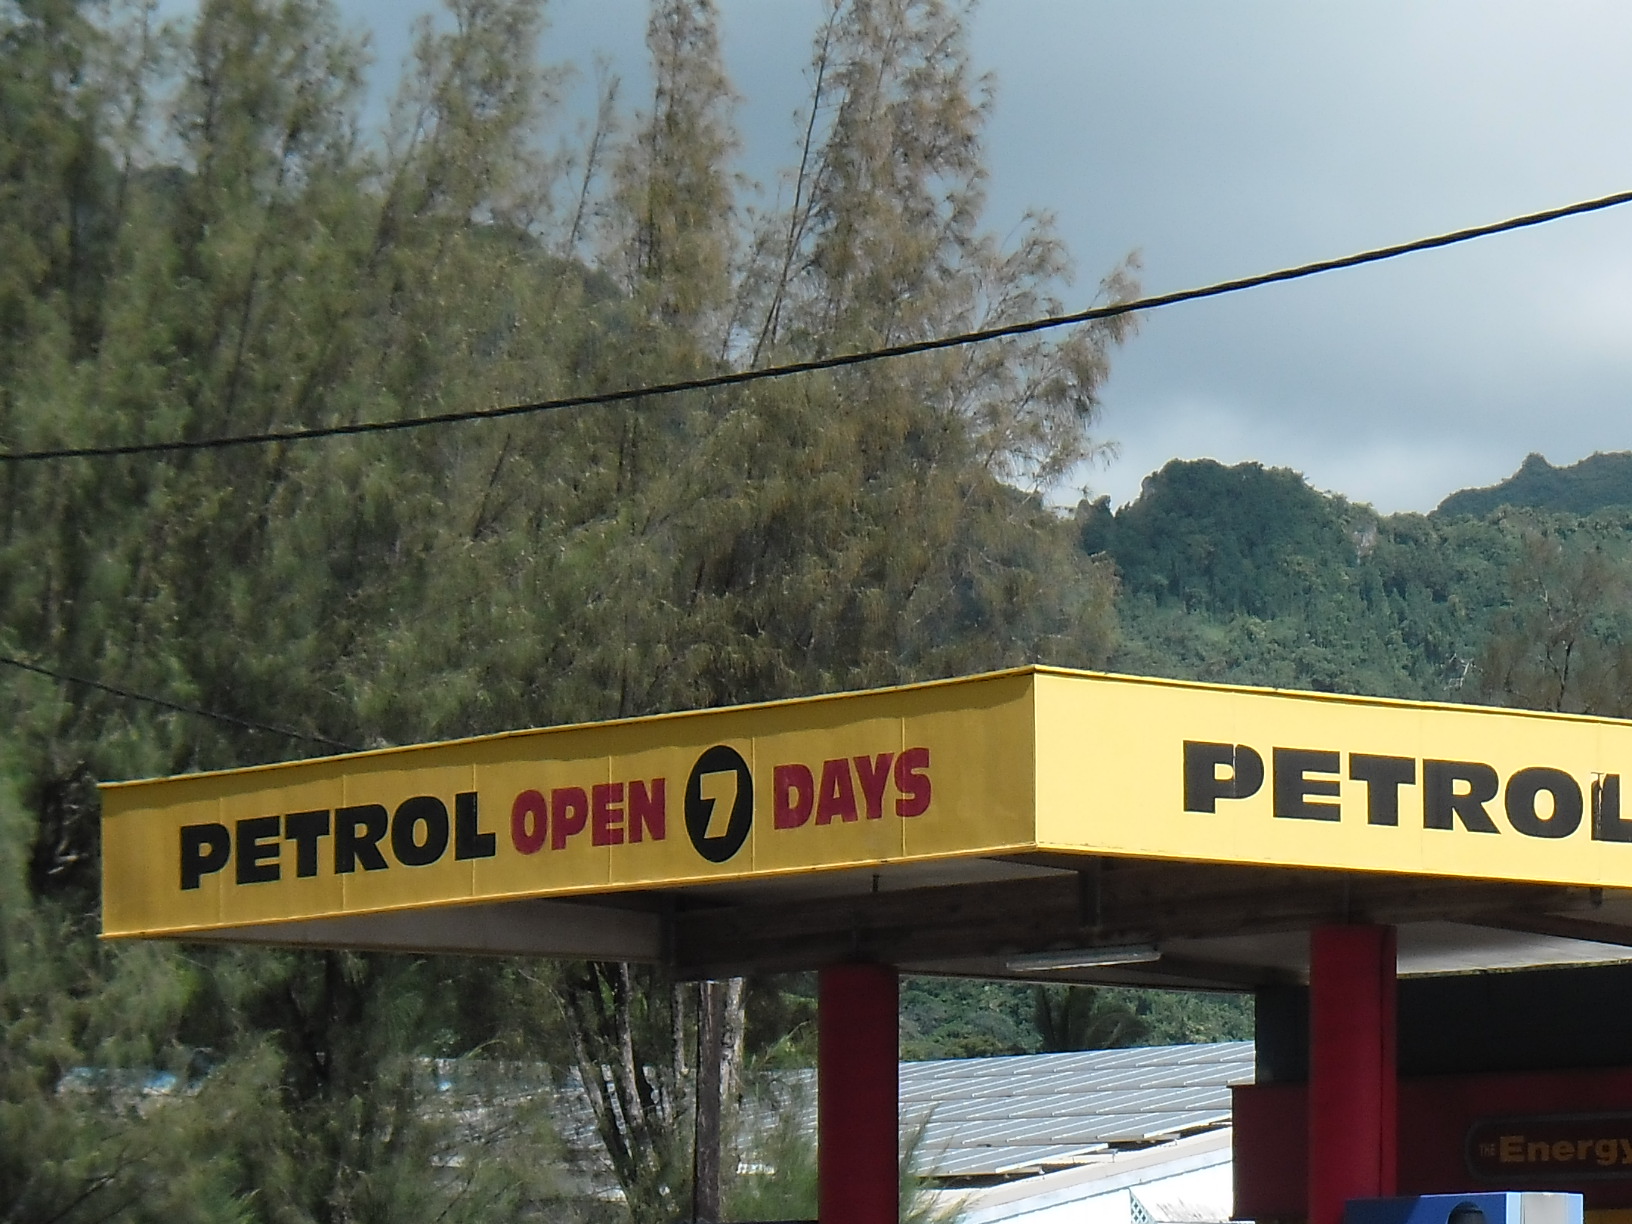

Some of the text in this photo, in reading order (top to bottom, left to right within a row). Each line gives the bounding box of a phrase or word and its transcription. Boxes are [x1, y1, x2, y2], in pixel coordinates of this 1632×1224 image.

[180, 791, 497, 891] PETROL
[510, 777, 667, 855] OPEN
[773, 747, 932, 831] DAYS
